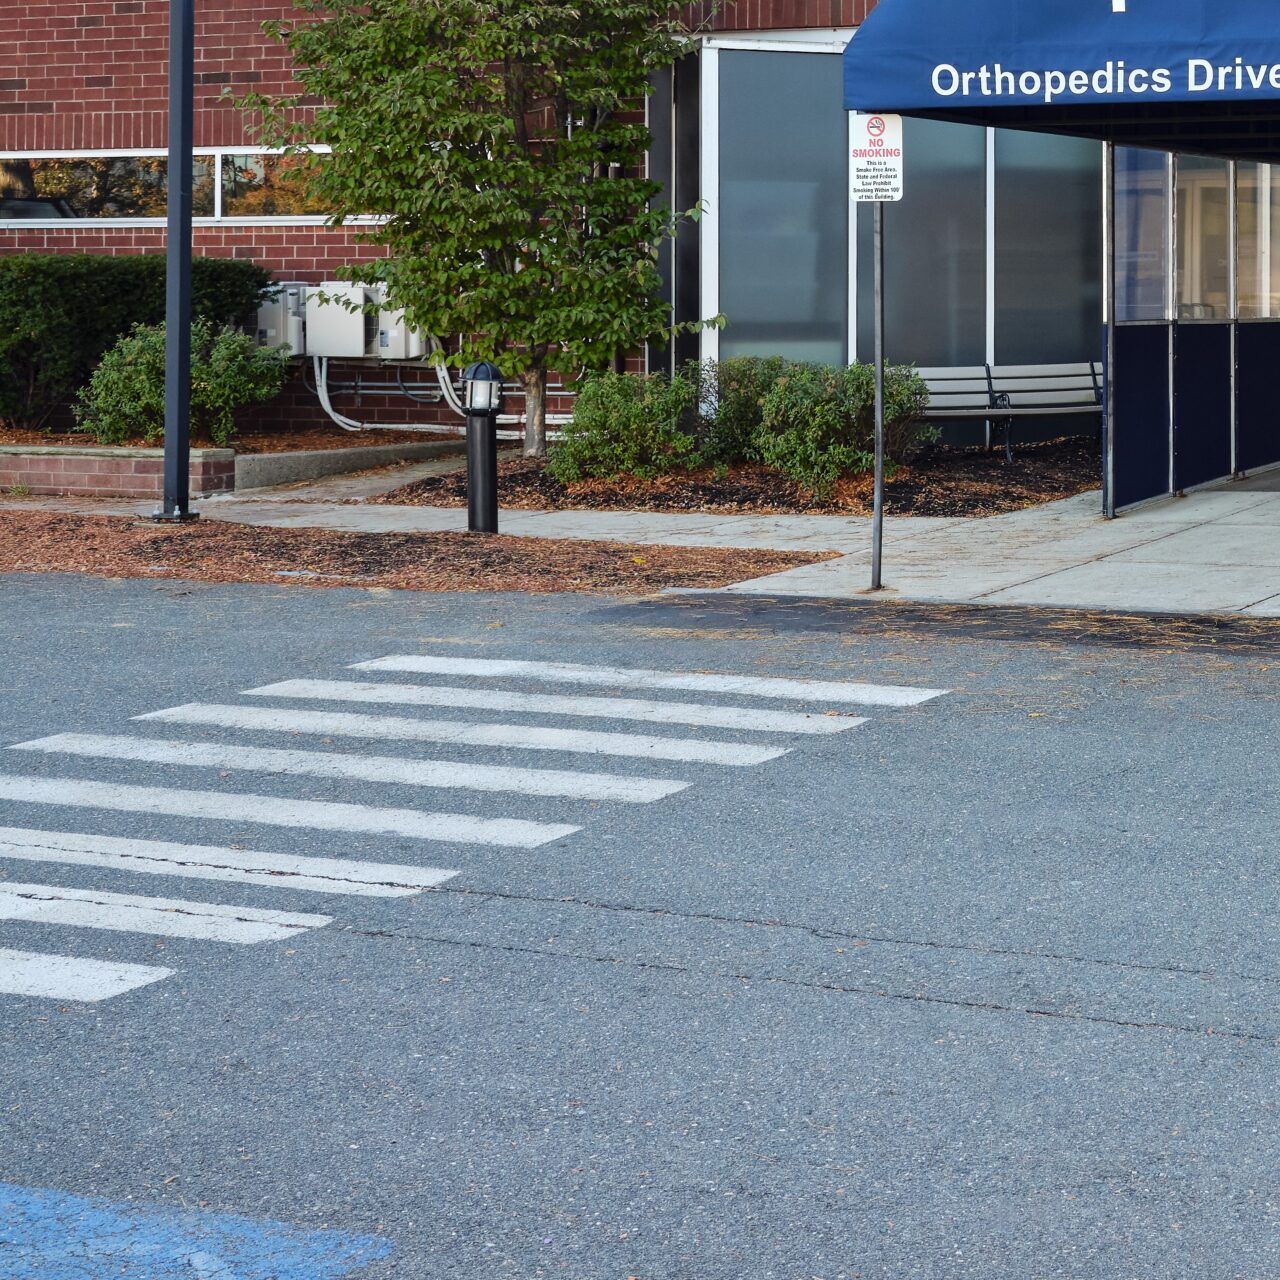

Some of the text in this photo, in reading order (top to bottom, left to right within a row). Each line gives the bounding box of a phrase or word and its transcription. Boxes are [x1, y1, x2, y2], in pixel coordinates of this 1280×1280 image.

[931, 60, 1172, 103] Orthopedics
[869, 139, 884, 147] NO
[852, 148, 901, 158] SMOKING
